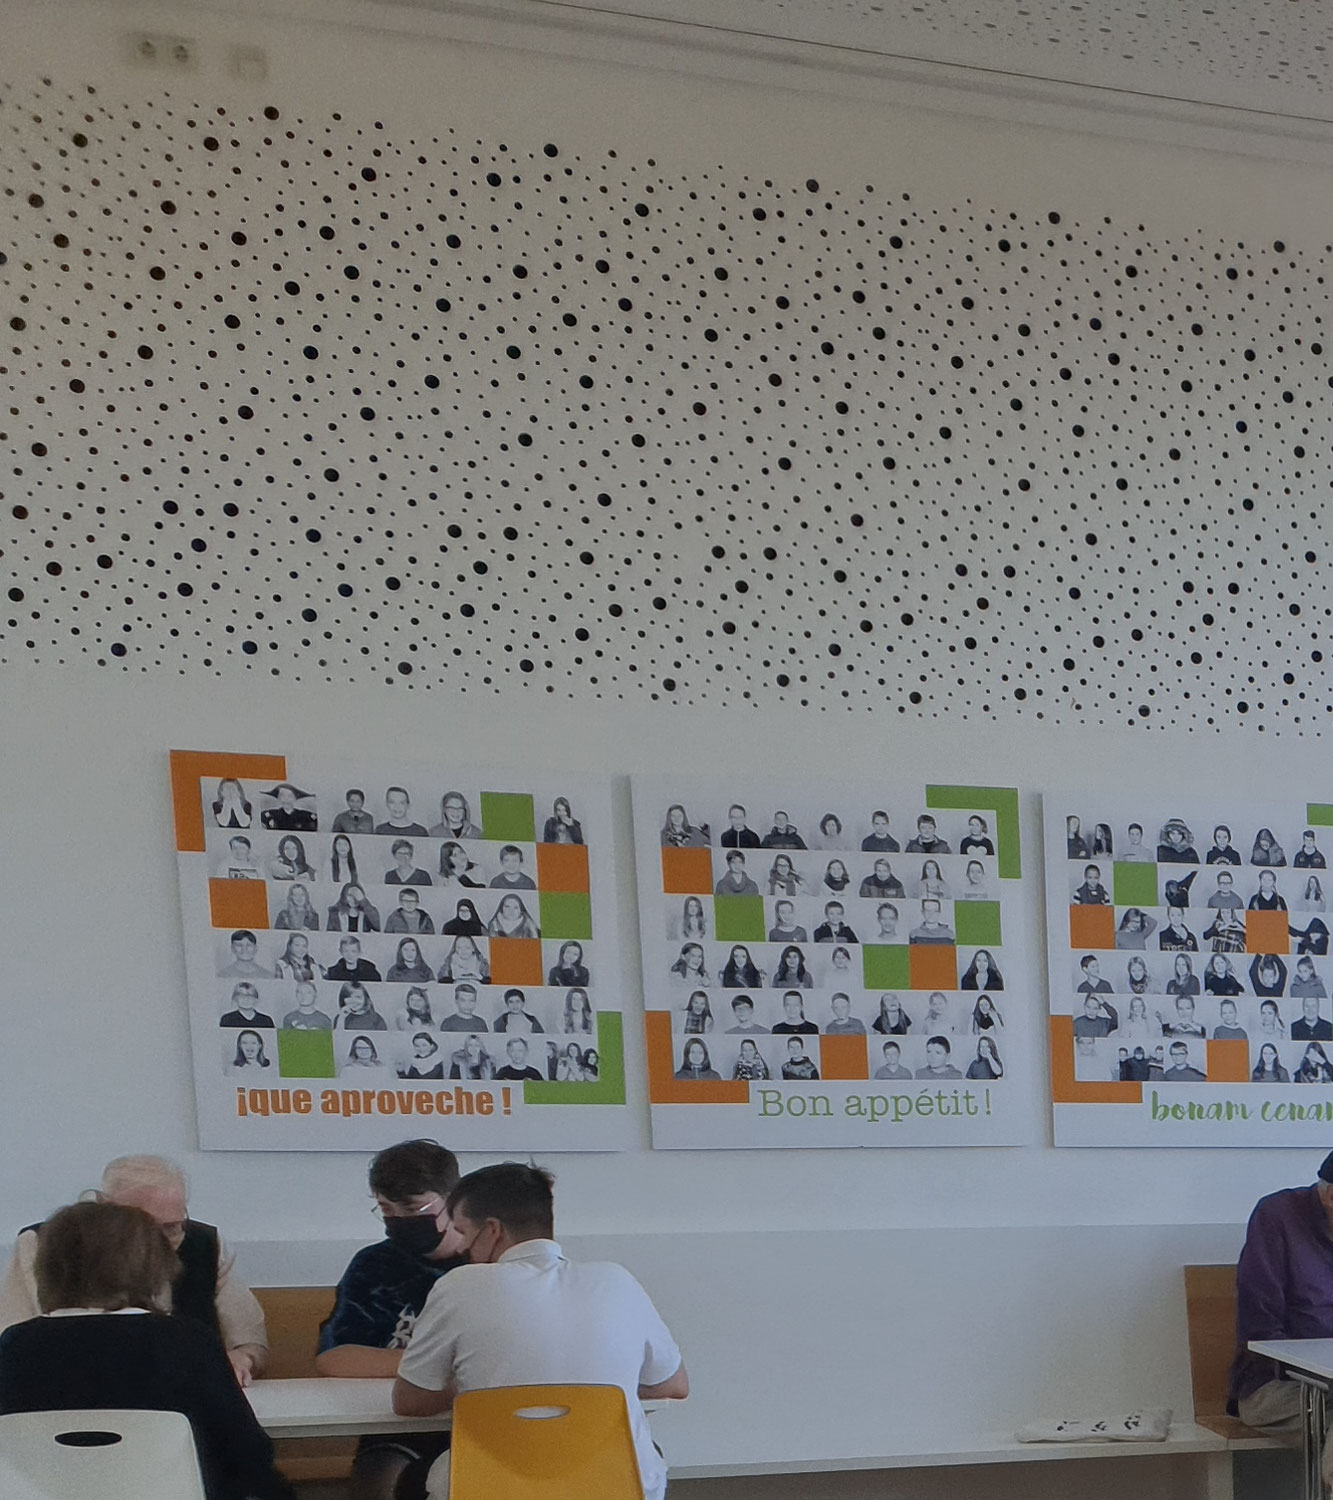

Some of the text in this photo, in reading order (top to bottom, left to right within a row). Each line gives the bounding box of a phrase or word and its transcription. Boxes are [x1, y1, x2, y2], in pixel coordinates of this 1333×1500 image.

[320, 1086, 494, 1117] aproveche
[757, 1089, 834, 1117] Bon
[1151, 1090, 1252, 1121] bonam
